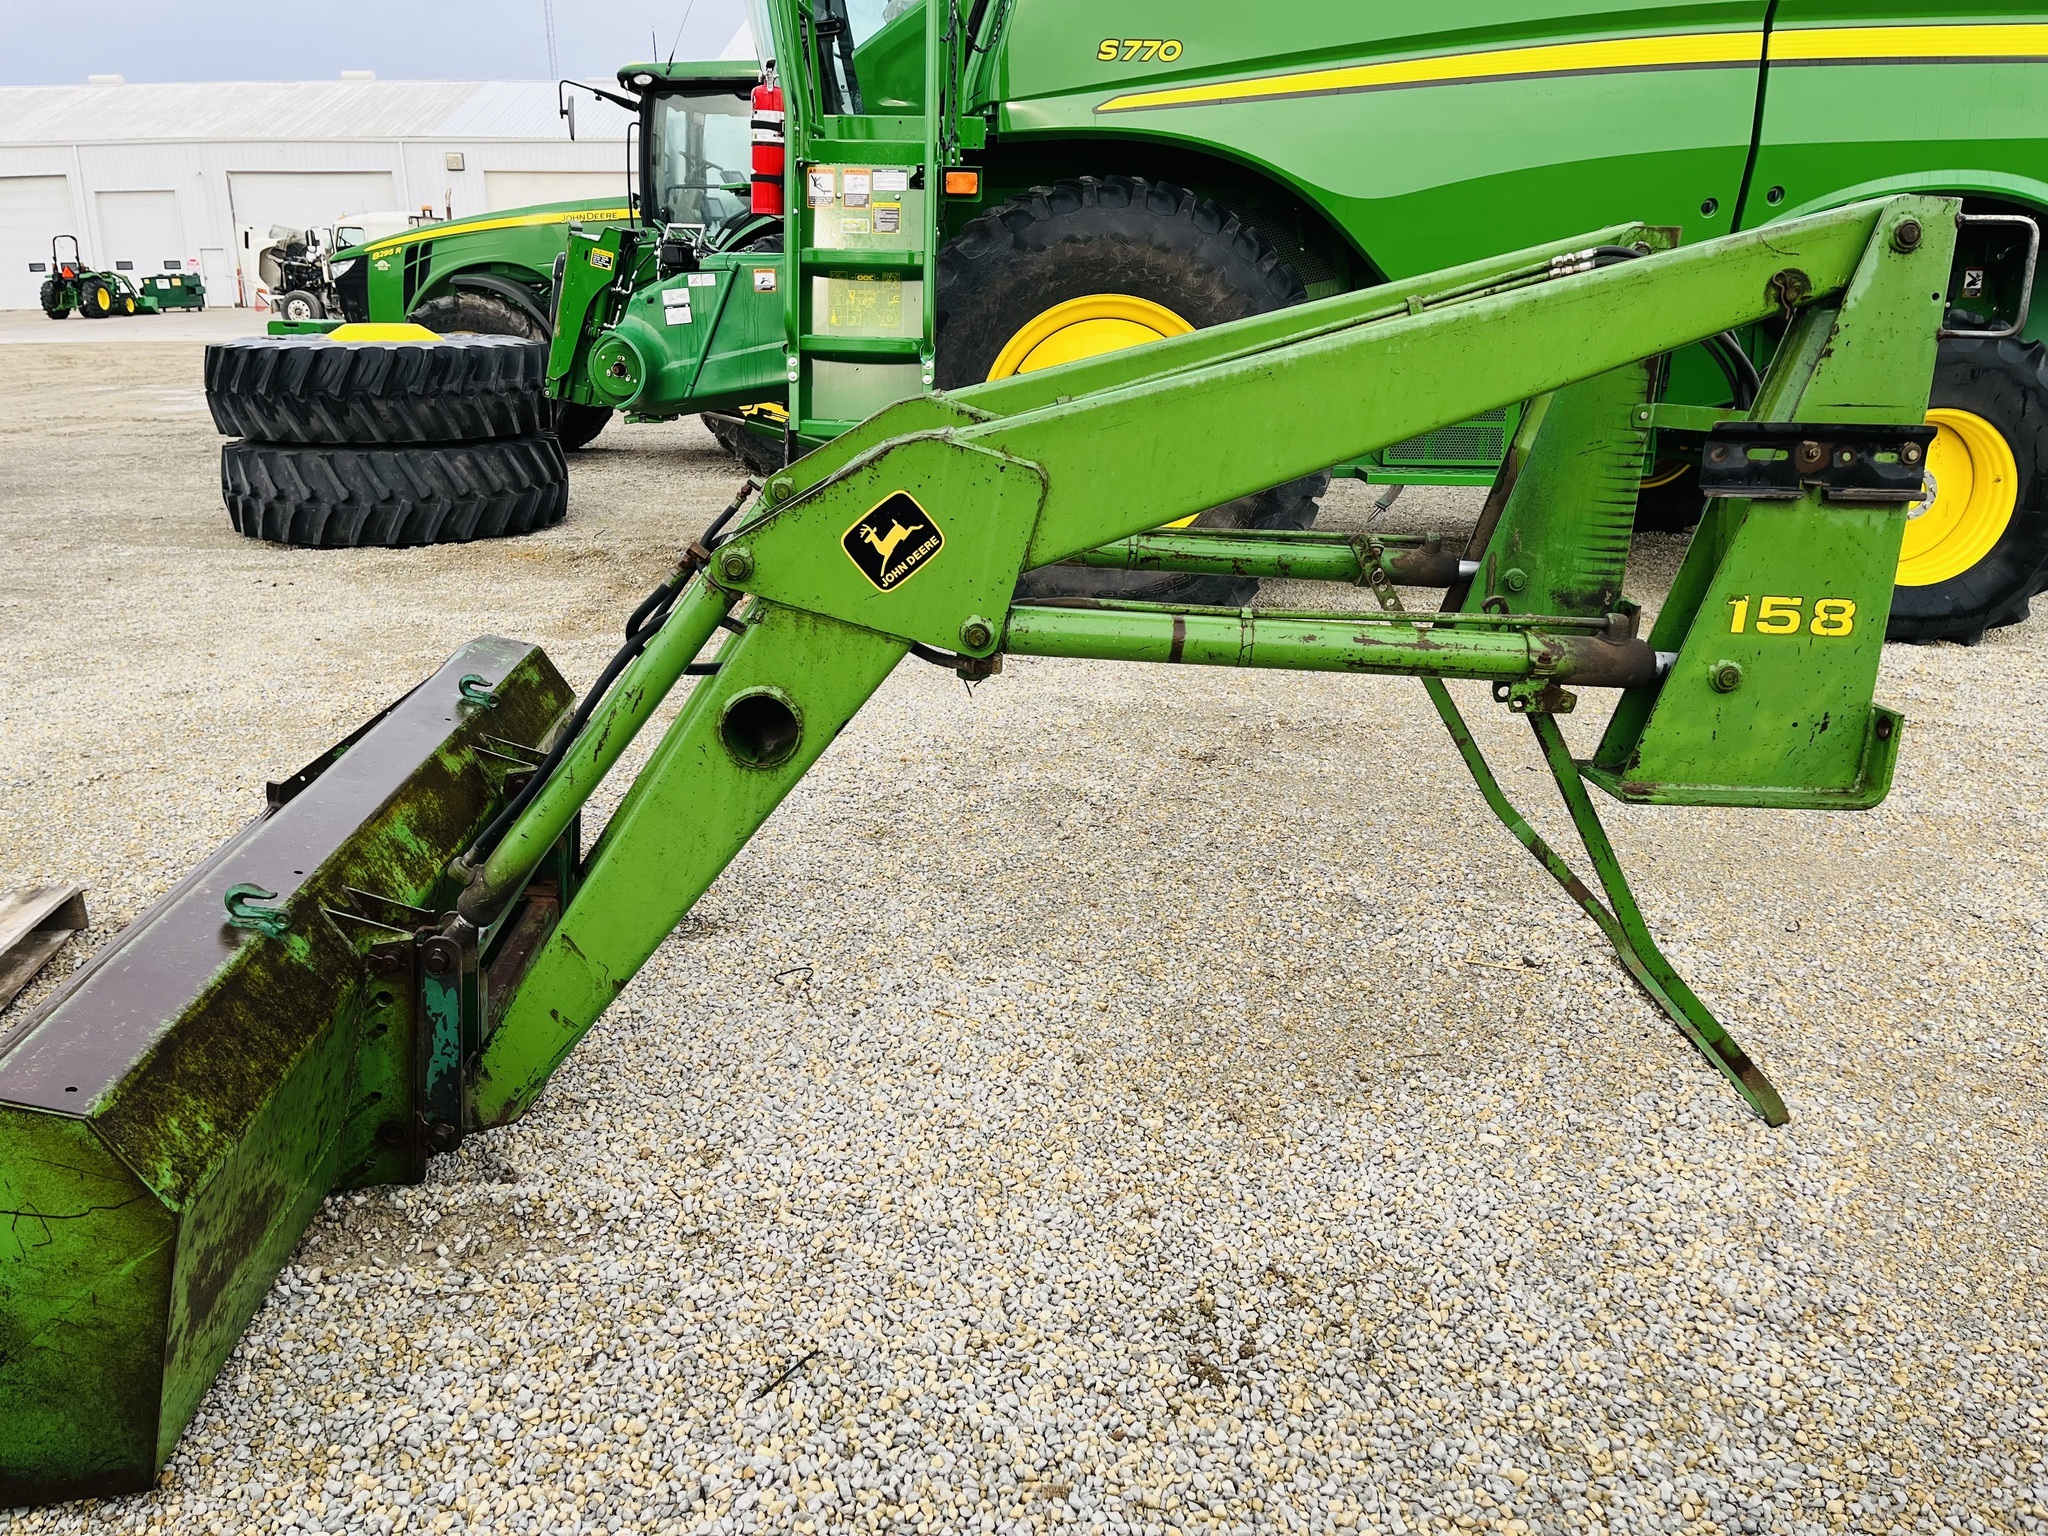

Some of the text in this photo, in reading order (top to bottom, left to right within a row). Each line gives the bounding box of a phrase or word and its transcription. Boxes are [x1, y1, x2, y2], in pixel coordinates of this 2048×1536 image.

[1096, 38, 1184, 62] S770
[371, 246, 403, 261] 8295 R
[881, 535, 940, 588] JOHN DEERE
[1727, 595, 1857, 637] 158
